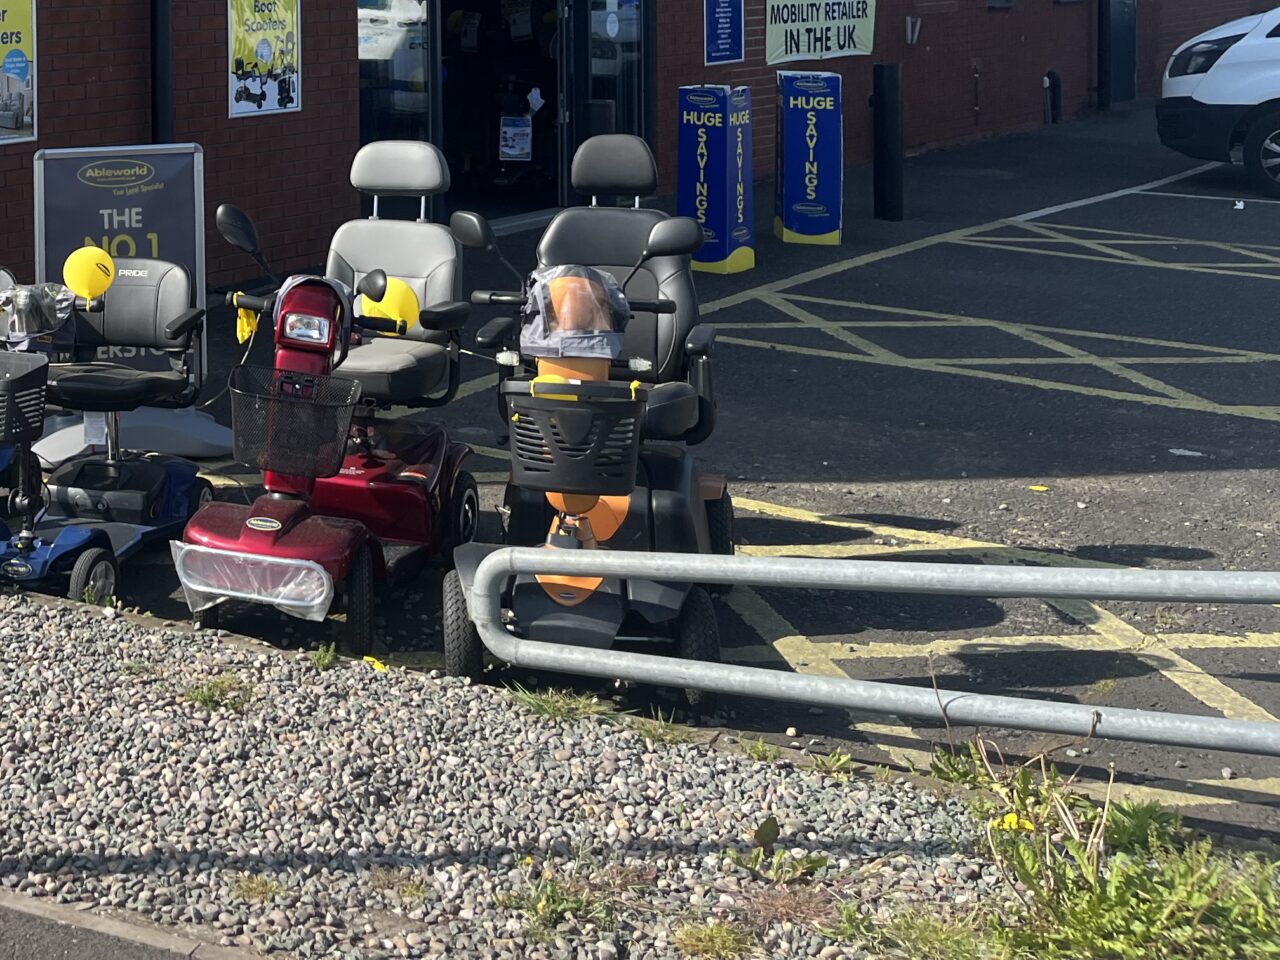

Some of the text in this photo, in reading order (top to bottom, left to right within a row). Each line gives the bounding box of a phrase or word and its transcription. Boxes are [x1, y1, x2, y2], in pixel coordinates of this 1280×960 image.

[254, 0, 278, 14] Boot
[770, 0, 869, 25] MOBILITY RETAILER
[244, 18, 288, 33] Scooters
[784, 24, 857, 55] IN THE UK
[789, 96, 835, 110] HUGE
[683, 110, 723, 127] HUGE
[729, 109, 750, 126] HUGE
[805, 111, 818, 200] SAVINGS
[85, 166, 148, 178] Ableworld
[696, 128, 708, 224] SAVINGS
[736, 127, 744, 223] SAVINGS
[99, 207, 143, 230] THE
[118, 269, 148, 277] PRIDE
